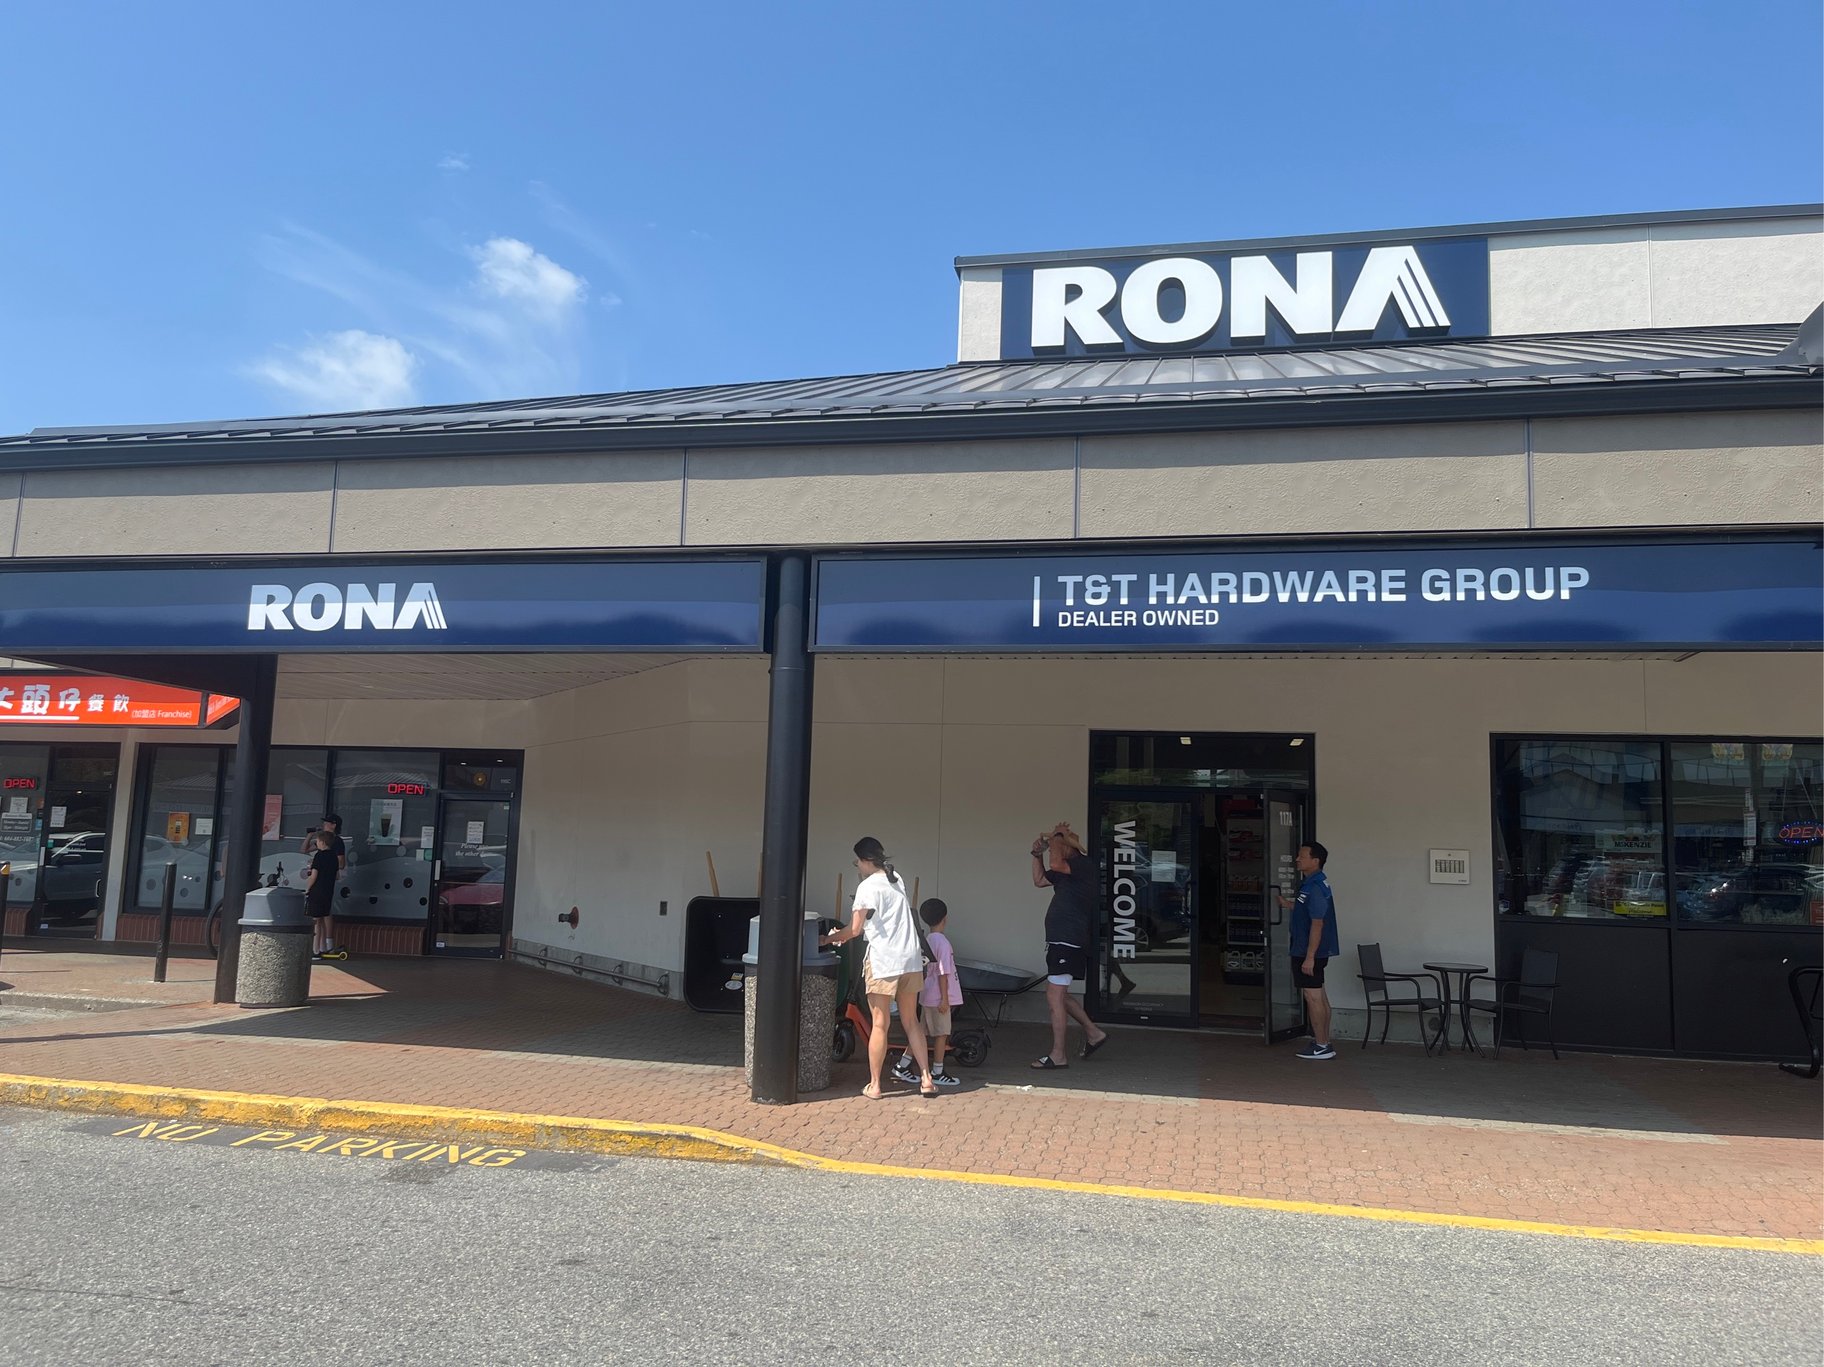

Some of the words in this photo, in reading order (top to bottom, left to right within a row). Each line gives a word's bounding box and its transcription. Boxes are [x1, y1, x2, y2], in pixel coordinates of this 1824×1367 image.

[1031, 245, 1451, 348] RONA
[1057, 574, 1137, 605] T&T
[1149, 570, 1407, 604] HARDWARE
[1421, 566, 1590, 601] GROUP
[247, 582, 448, 631] RONA
[1058, 610, 1137, 627] DEALER
[1142, 609, 1219, 626] OWNED
[3, 778, 36, 789] OPEN
[387, 783, 425, 795] OPEN
[1778, 826, 1824, 839] OPEN
[1113, 820, 1136, 959] WELCOME
[112, 1121, 219, 1142] NO
[229, 1130, 528, 1168] PARKING
